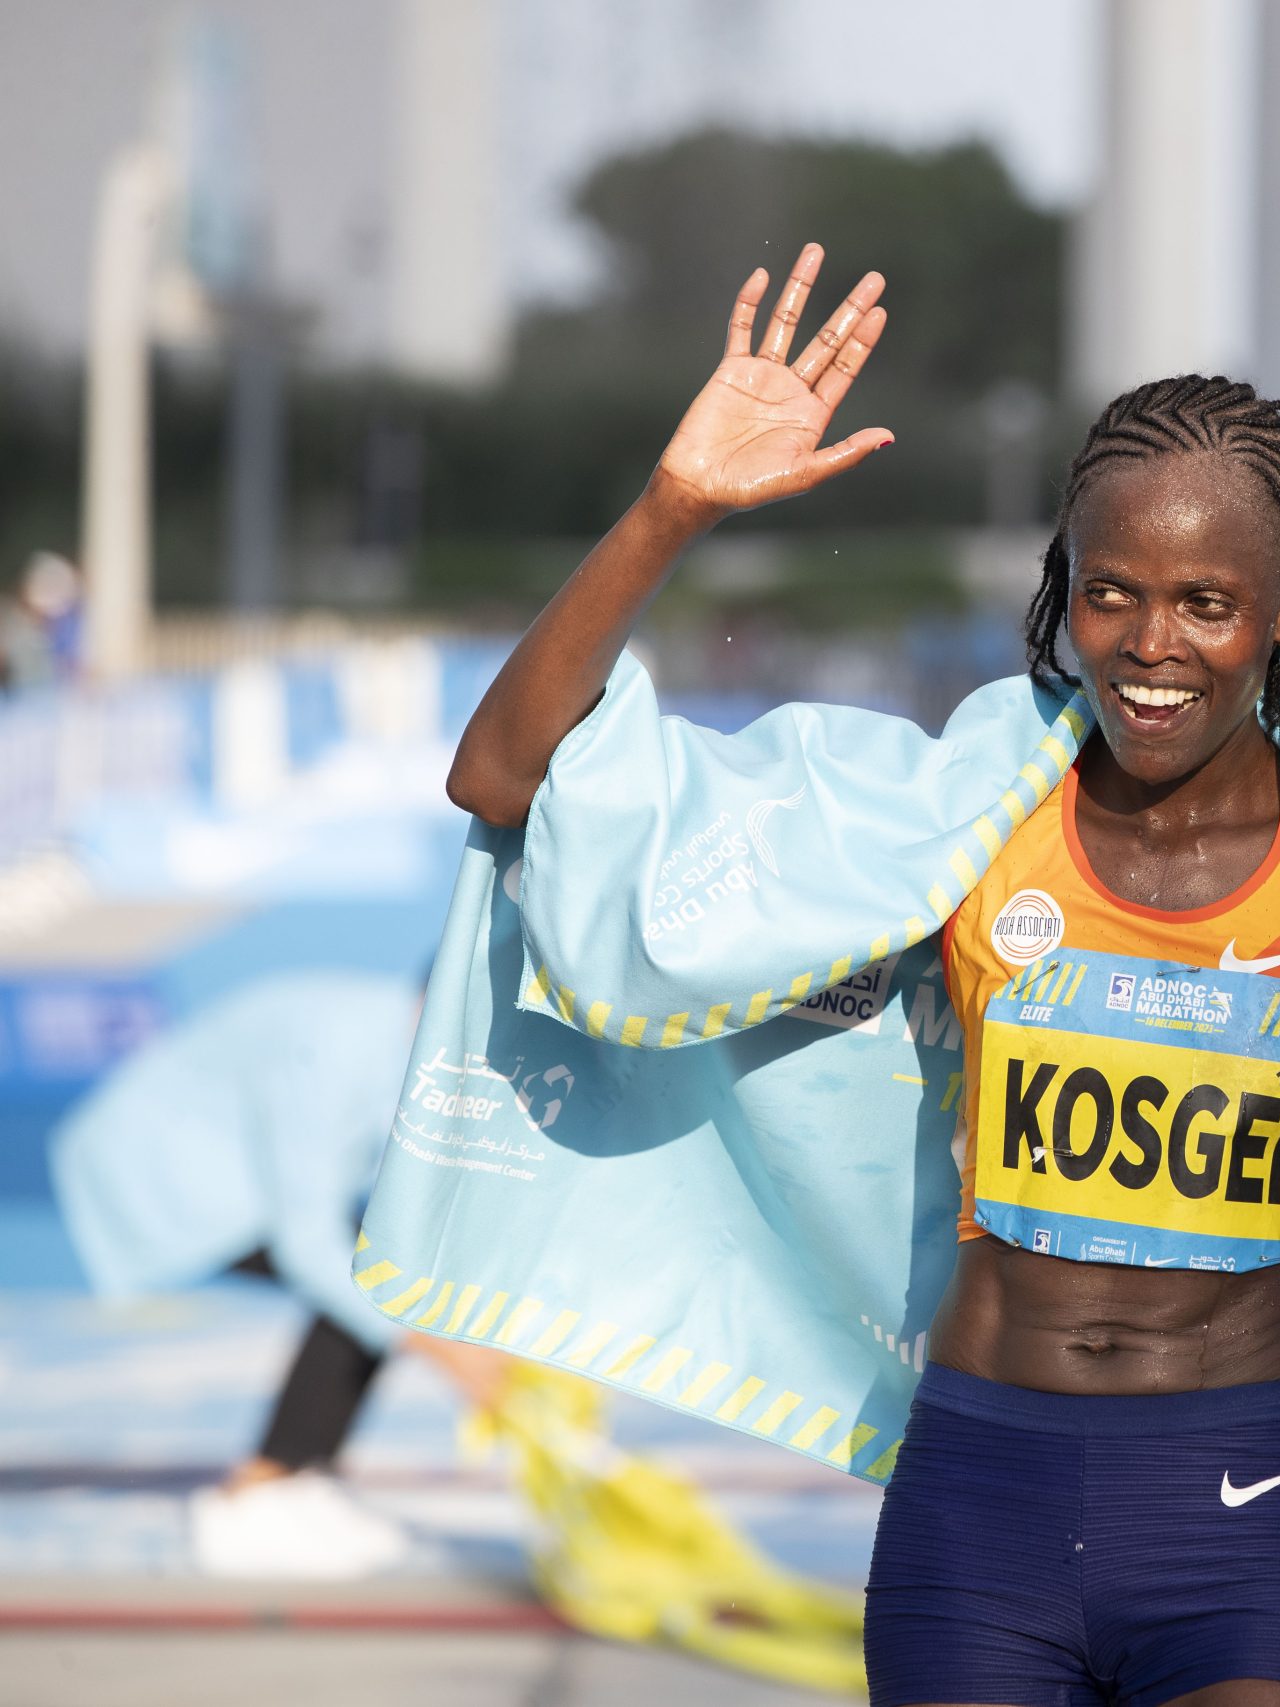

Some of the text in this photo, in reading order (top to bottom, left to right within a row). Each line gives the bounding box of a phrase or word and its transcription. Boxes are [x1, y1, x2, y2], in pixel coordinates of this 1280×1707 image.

[681, 832, 749, 889] Sports
[642, 860, 759, 941] Abu Dha
[994, 915, 1061, 938] ROSA ASSOCIATI
[1138, 991, 1206, 1008] ABU DHABI
[1139, 977, 1208, 999] ADNOC
[799, 990, 874, 1021] DNOC
[1018, 1004, 1054, 1023] ELITE
[1135, 1000, 1229, 1025] MARATHON
[408, 1068, 504, 1121] Tadeer
[401, 1138, 435, 1164] Dhabi
[502, 1164, 538, 1181] Center
[1088, 1244, 1126, 1257] Abu Dhabi
[1189, 1261, 1220, 1271] Tadweer
